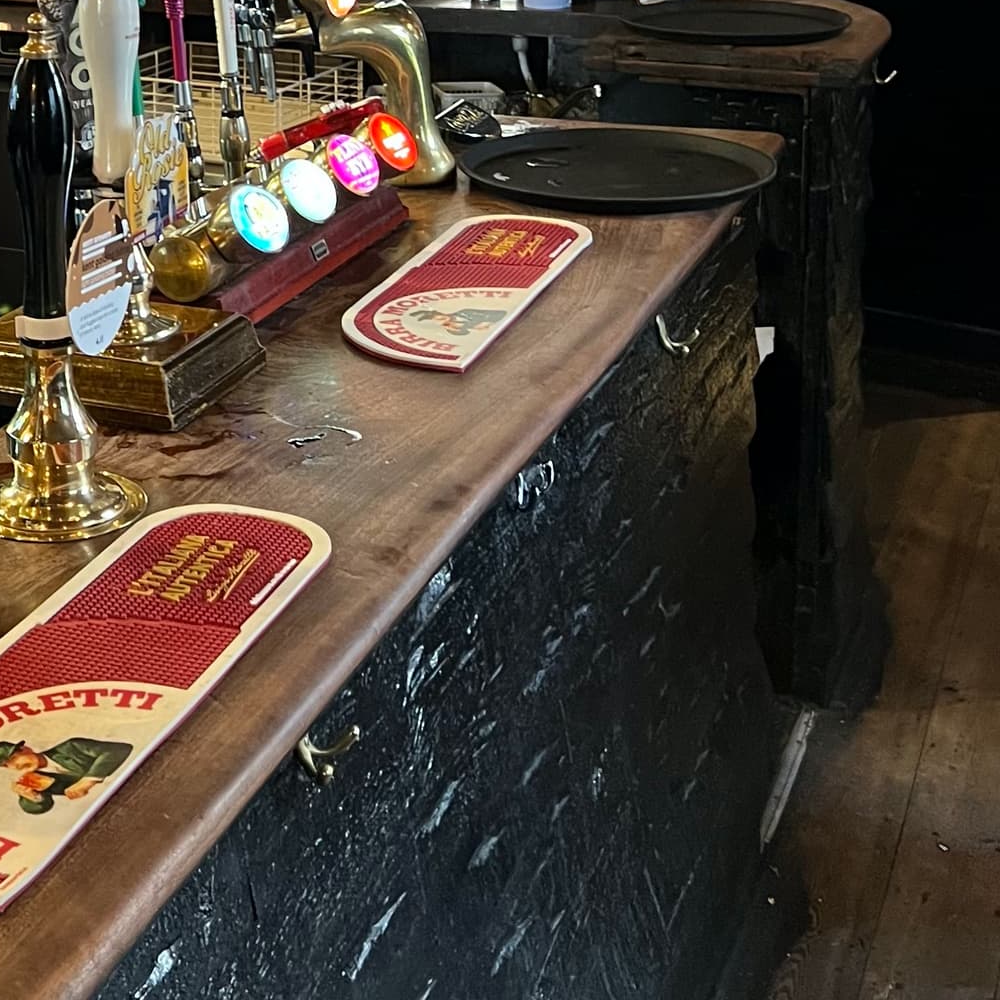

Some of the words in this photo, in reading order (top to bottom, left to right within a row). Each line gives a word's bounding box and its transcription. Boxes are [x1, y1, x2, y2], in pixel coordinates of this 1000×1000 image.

[138, 112, 173, 158] Old
[133, 144, 185, 204] Rosie
[383, 290, 512, 316] MORETTI
[380, 318, 457, 351] BIRRA
[128, 535, 210, 596] L'ITALIANA
[160, 539, 239, 602] AUTENTICA
